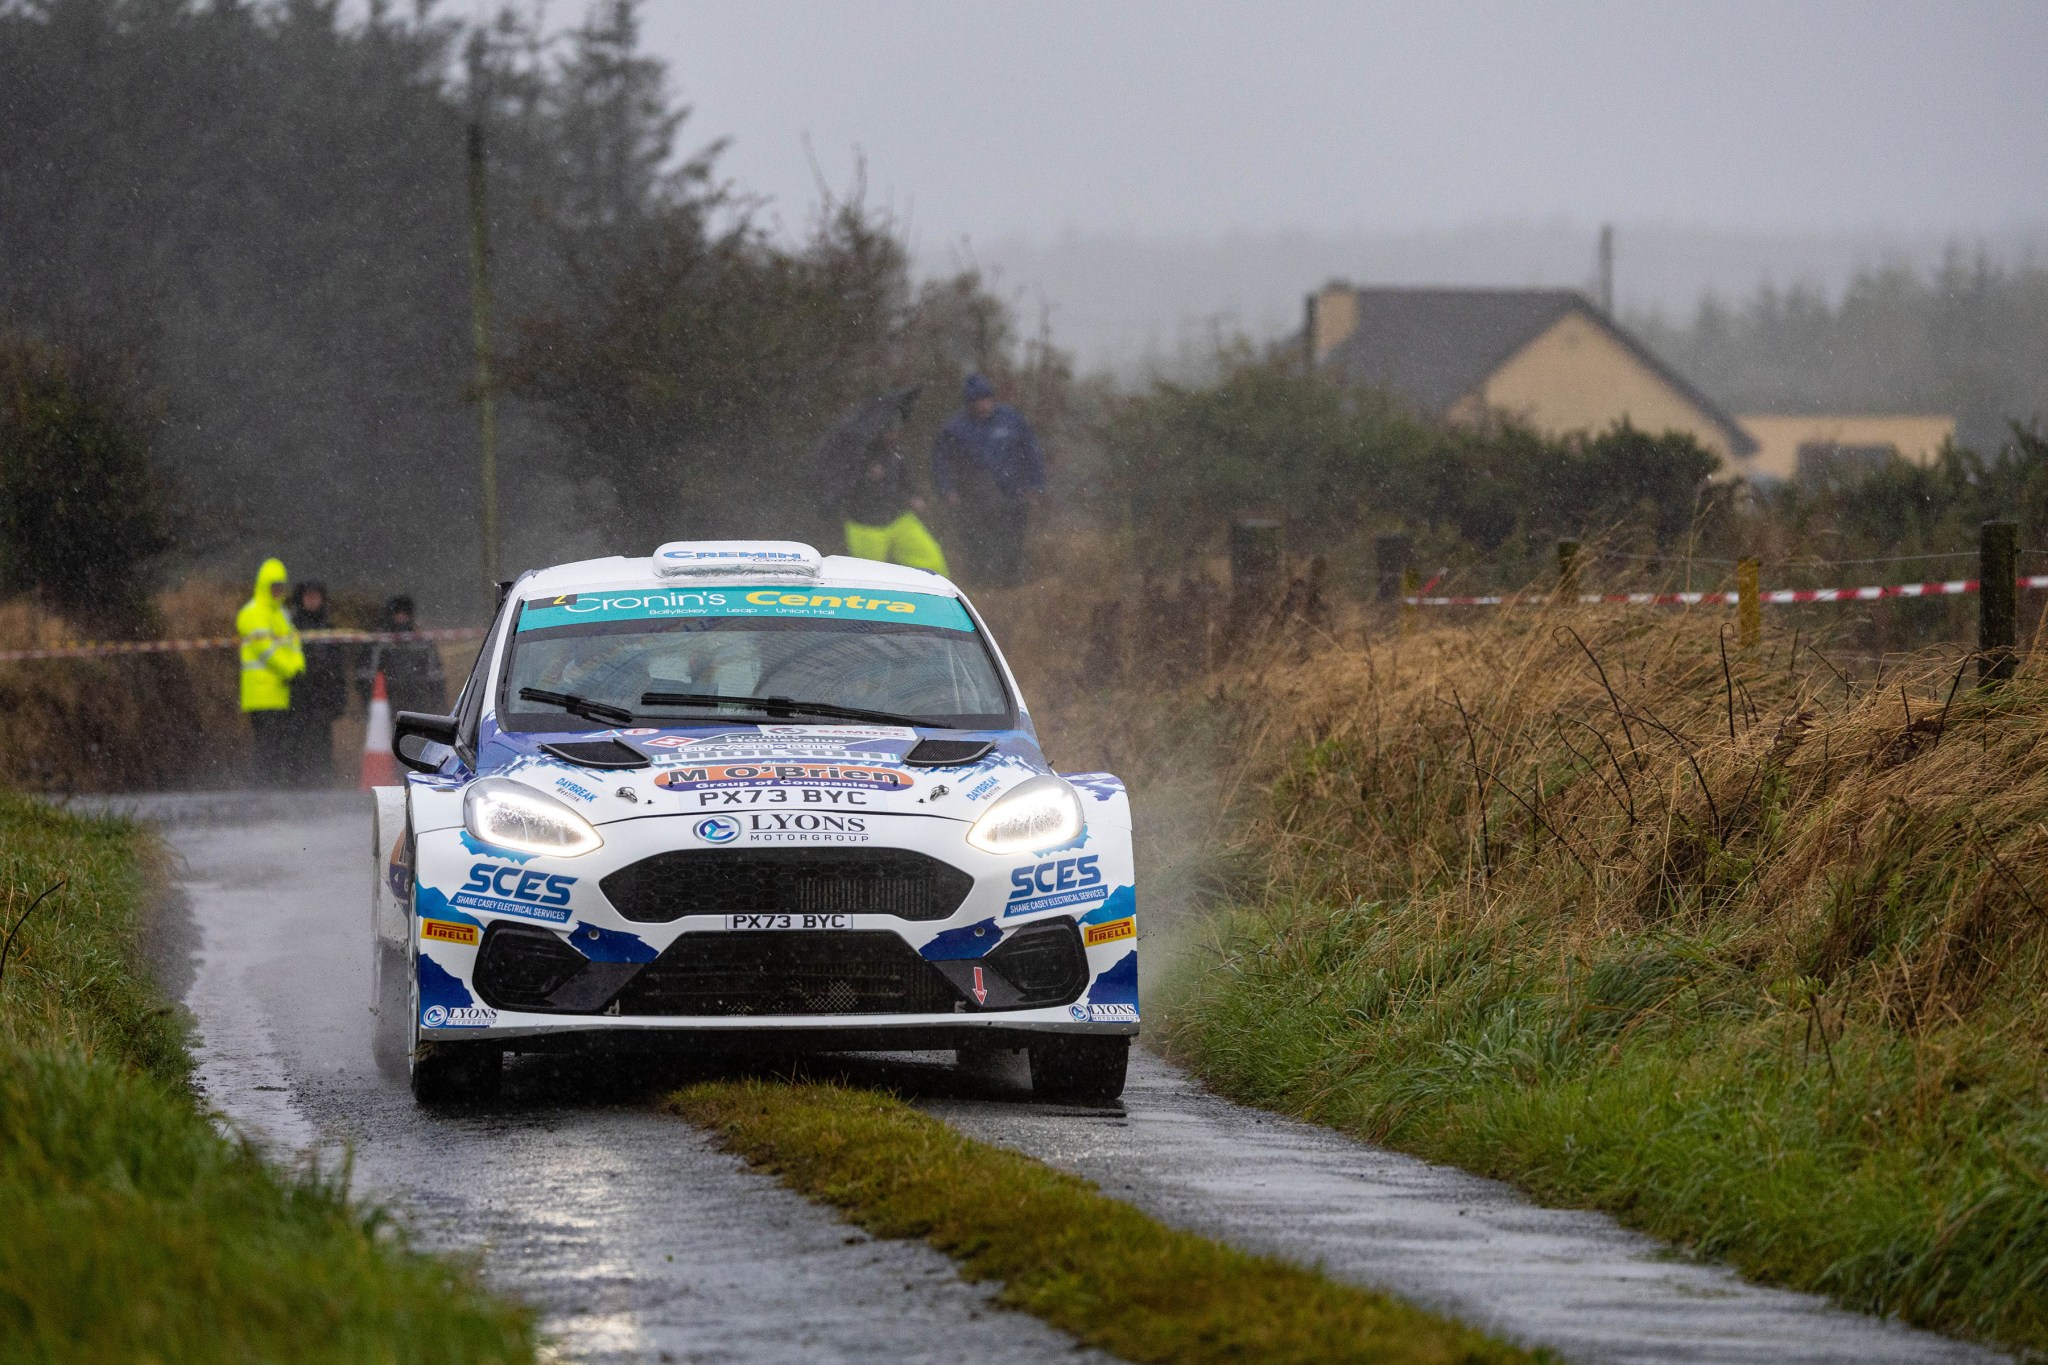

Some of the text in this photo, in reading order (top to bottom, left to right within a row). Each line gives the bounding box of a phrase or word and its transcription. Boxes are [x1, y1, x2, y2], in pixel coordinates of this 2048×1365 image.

[663, 551, 801, 560] CREMIN
[565, 591, 916, 614] Cronin's Centra
[669, 766, 900, 785] M O'Brien
[695, 781, 750, 789] Group
[779, 779, 879, 789] Companies
[555, 777, 598, 803] DAYBREAK
[699, 789, 867, 807] PX73 BYC
[966, 776, 1000, 801] DAYBREAK
[749, 814, 866, 832] LYONS
[750, 834, 869, 842] MOTORGROUP
[461, 863, 578, 906] SCES
[1009, 854, 1101, 900] SCES
[456, 895, 566, 920] SHANE CASEY ELECTRICAL SERVICES
[1010, 889, 1105, 914] SHANE CASEY ELECTRICAL SERVICES
[733, 914, 846, 929] PX73 BYC
[426, 922, 474, 942] PIRELLI
[1088, 921, 1132, 943] PIRELLI
[450, 1008, 498, 1019] LYONS
[1090, 1004, 1136, 1015] LYONS
